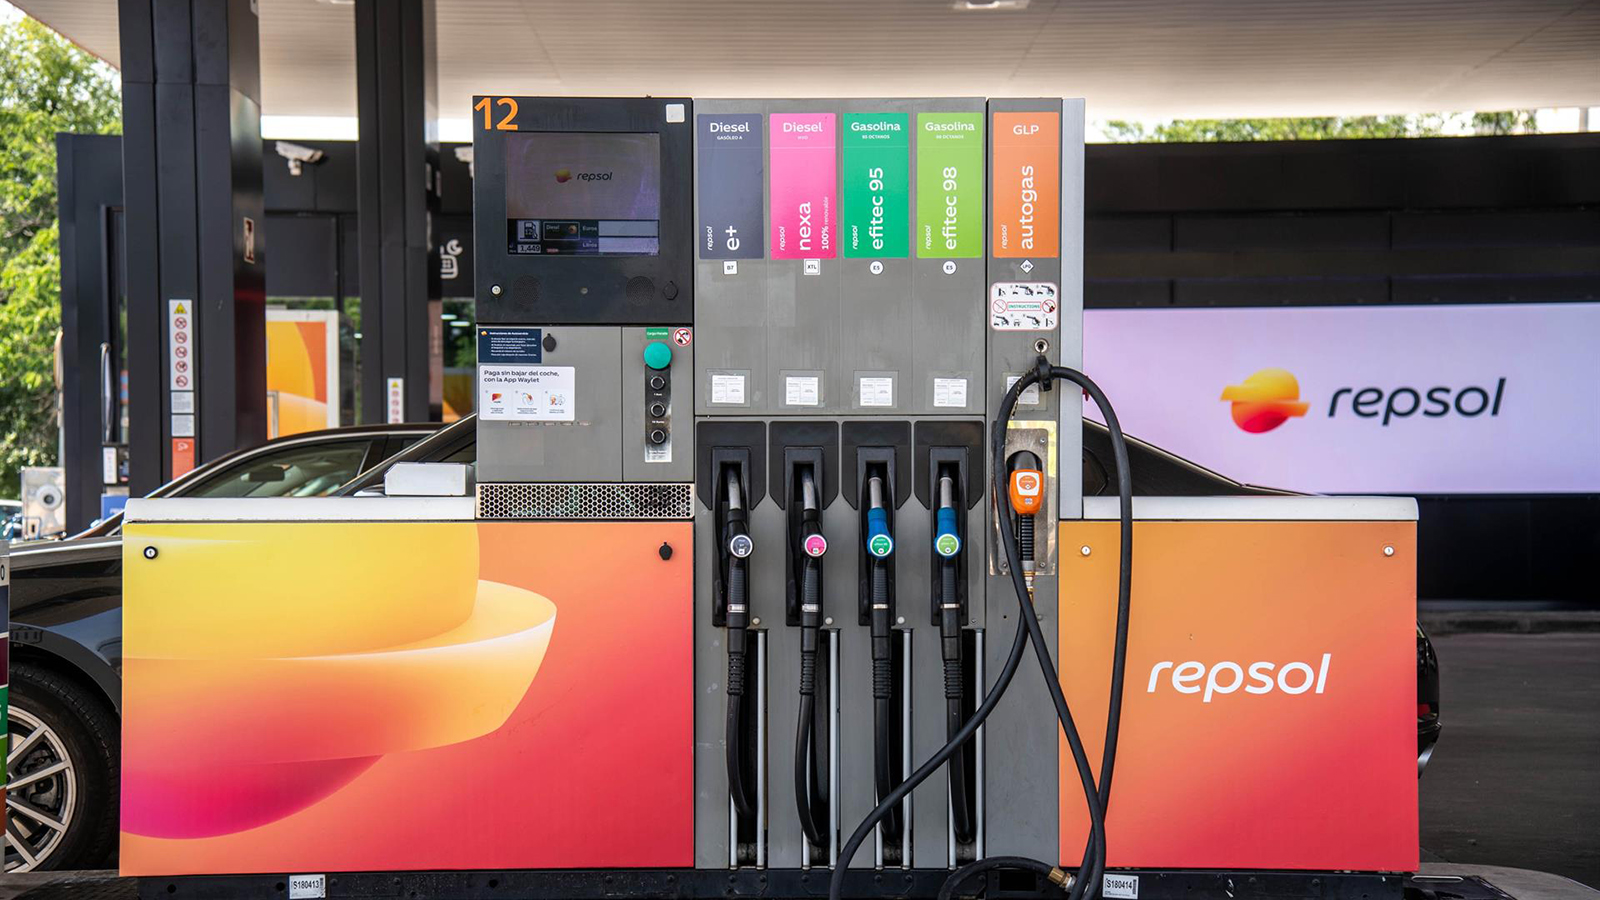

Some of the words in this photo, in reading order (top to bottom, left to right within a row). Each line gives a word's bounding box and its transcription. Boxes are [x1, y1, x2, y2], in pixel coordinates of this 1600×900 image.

[474, 97, 519, 131] 12
[850, 121, 901, 132] Gasolina
[924, 121, 975, 132] Gasolina
[709, 121, 750, 133] Diesel
[783, 121, 823, 133] Diesel
[1013, 124, 1040, 135] GLP
[576, 171, 613, 182] repsol
[868, 167, 884, 191] 95
[942, 166, 957, 191] 98
[1019, 165, 1037, 250] autogas
[799, 201, 811, 251] nexa
[868, 195, 884, 250] efitec
[942, 195, 957, 250] efitec
[706, 225, 714, 251] repsol
[725, 225, 740, 251] e+
[778, 225, 786, 251] repsol
[821, 225, 829, 250] 100%
[851, 224, 859, 250] repsol
[924, 224, 932, 250] repsol
[511, 369, 527, 377] bajar
[1328, 377, 1507, 427] repsol
[1147, 653, 1331, 703] repsol
[293, 880, 319, 890] S180413
[1106, 880, 1132, 889] S180414
